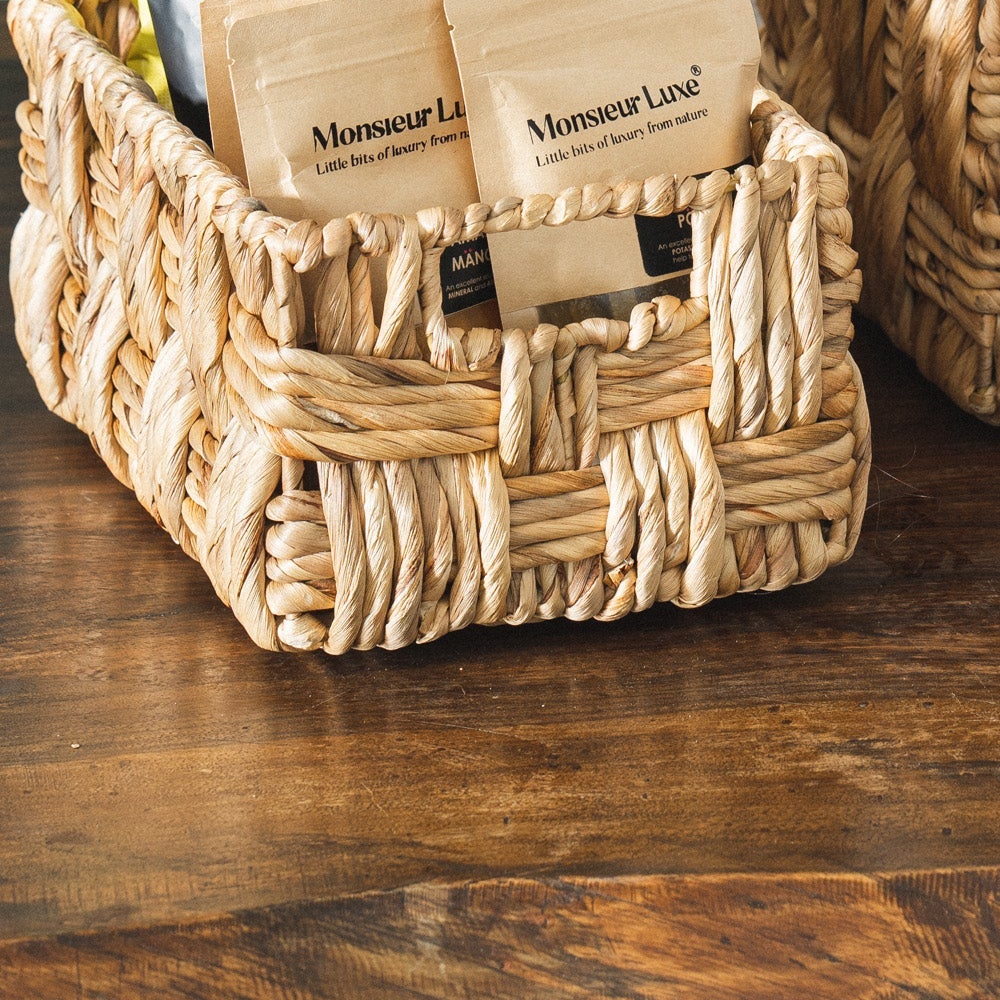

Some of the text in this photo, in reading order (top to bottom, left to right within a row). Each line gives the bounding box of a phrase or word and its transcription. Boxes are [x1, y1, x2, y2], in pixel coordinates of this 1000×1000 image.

[312, 107, 433, 152] Monsieur
[527, 95, 641, 145] Monsieur
[536, 107, 709, 167] Little bits of luxury from nature
[316, 158, 348, 176] Little
[351, 153, 375, 168] bits
[377, 146, 390, 161] of
[392, 141, 427, 158] luxury
[430, 133, 457, 147] from
